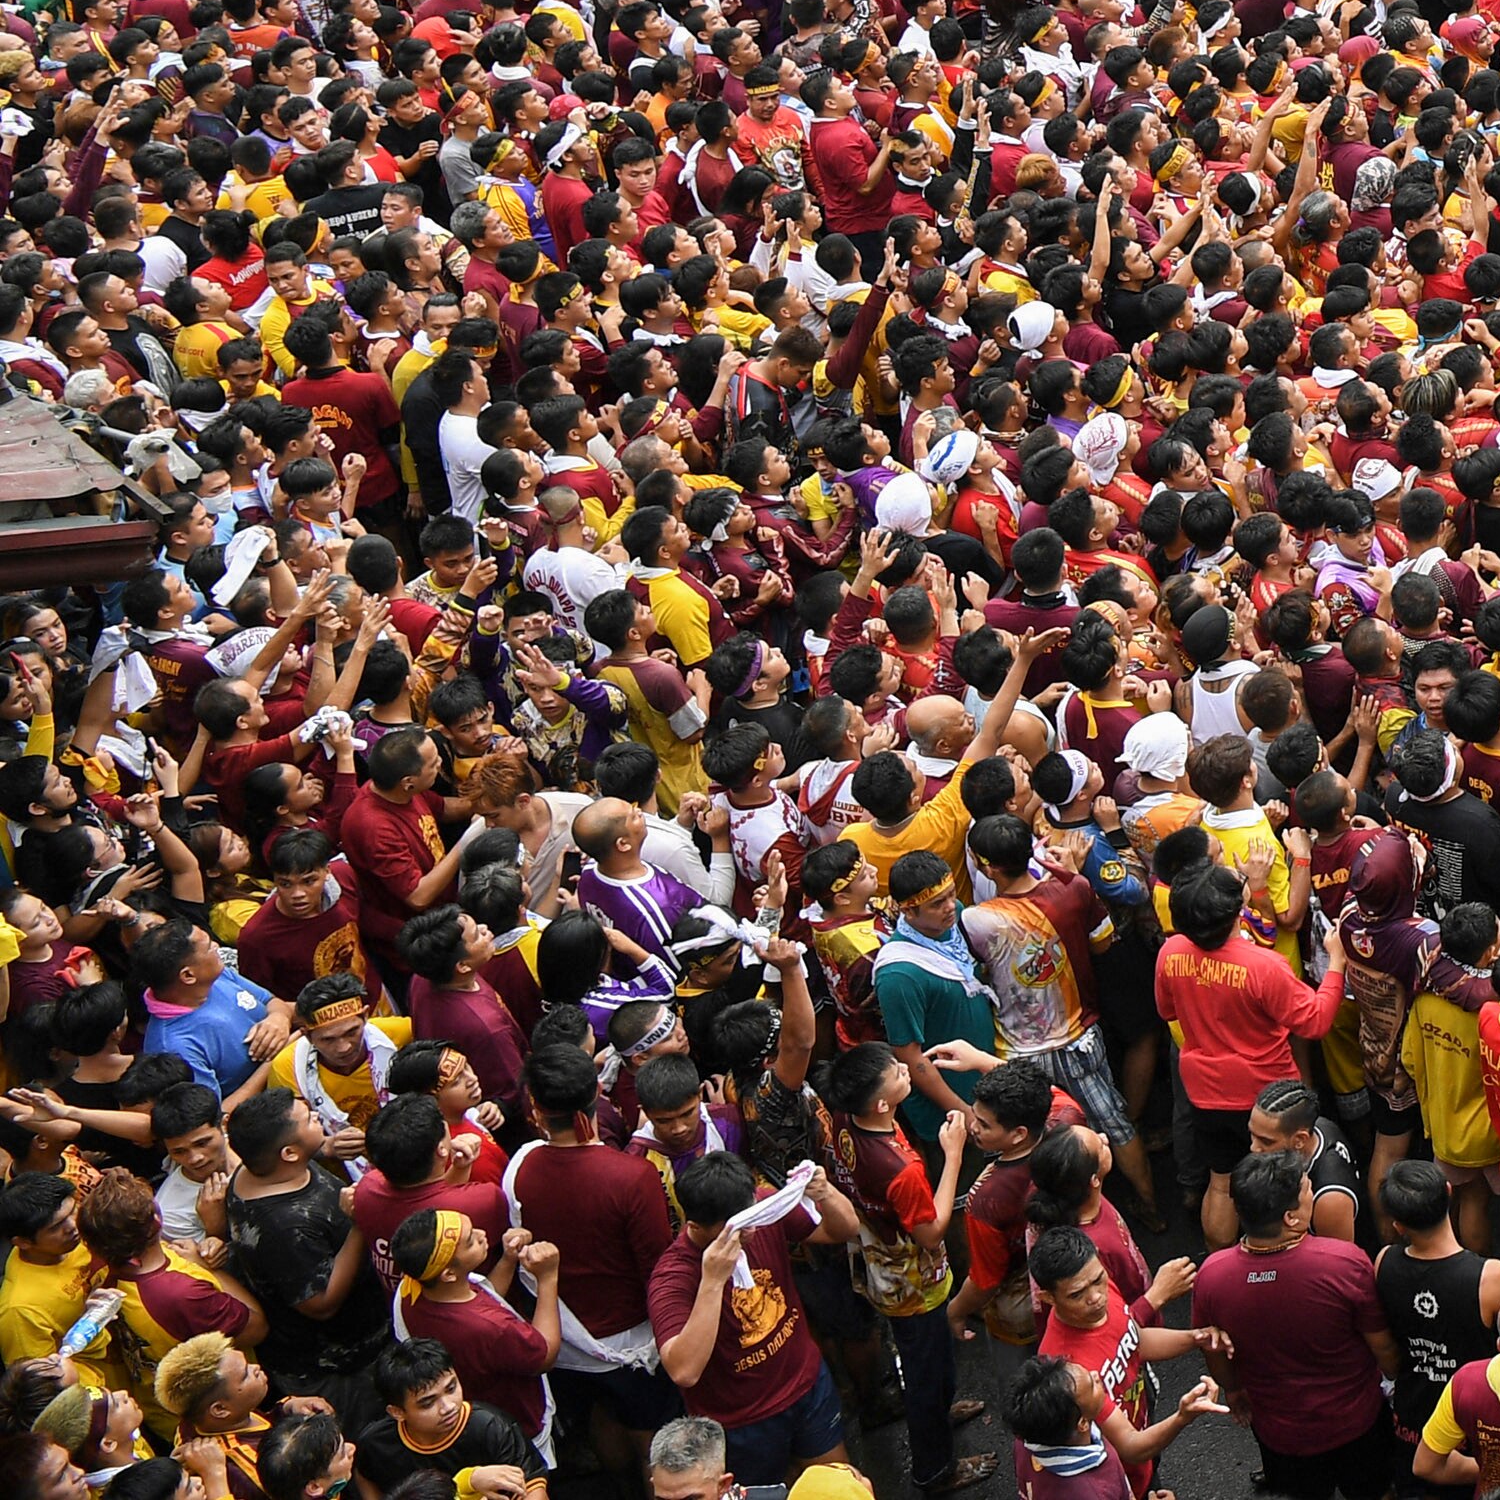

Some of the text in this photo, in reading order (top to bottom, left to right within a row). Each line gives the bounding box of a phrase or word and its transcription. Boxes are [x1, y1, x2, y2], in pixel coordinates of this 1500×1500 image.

[547, 575, 575, 614] QUIAPO
[643, 1027, 666, 1047] VIVA
[733, 1351, 767, 1374] JESUS
